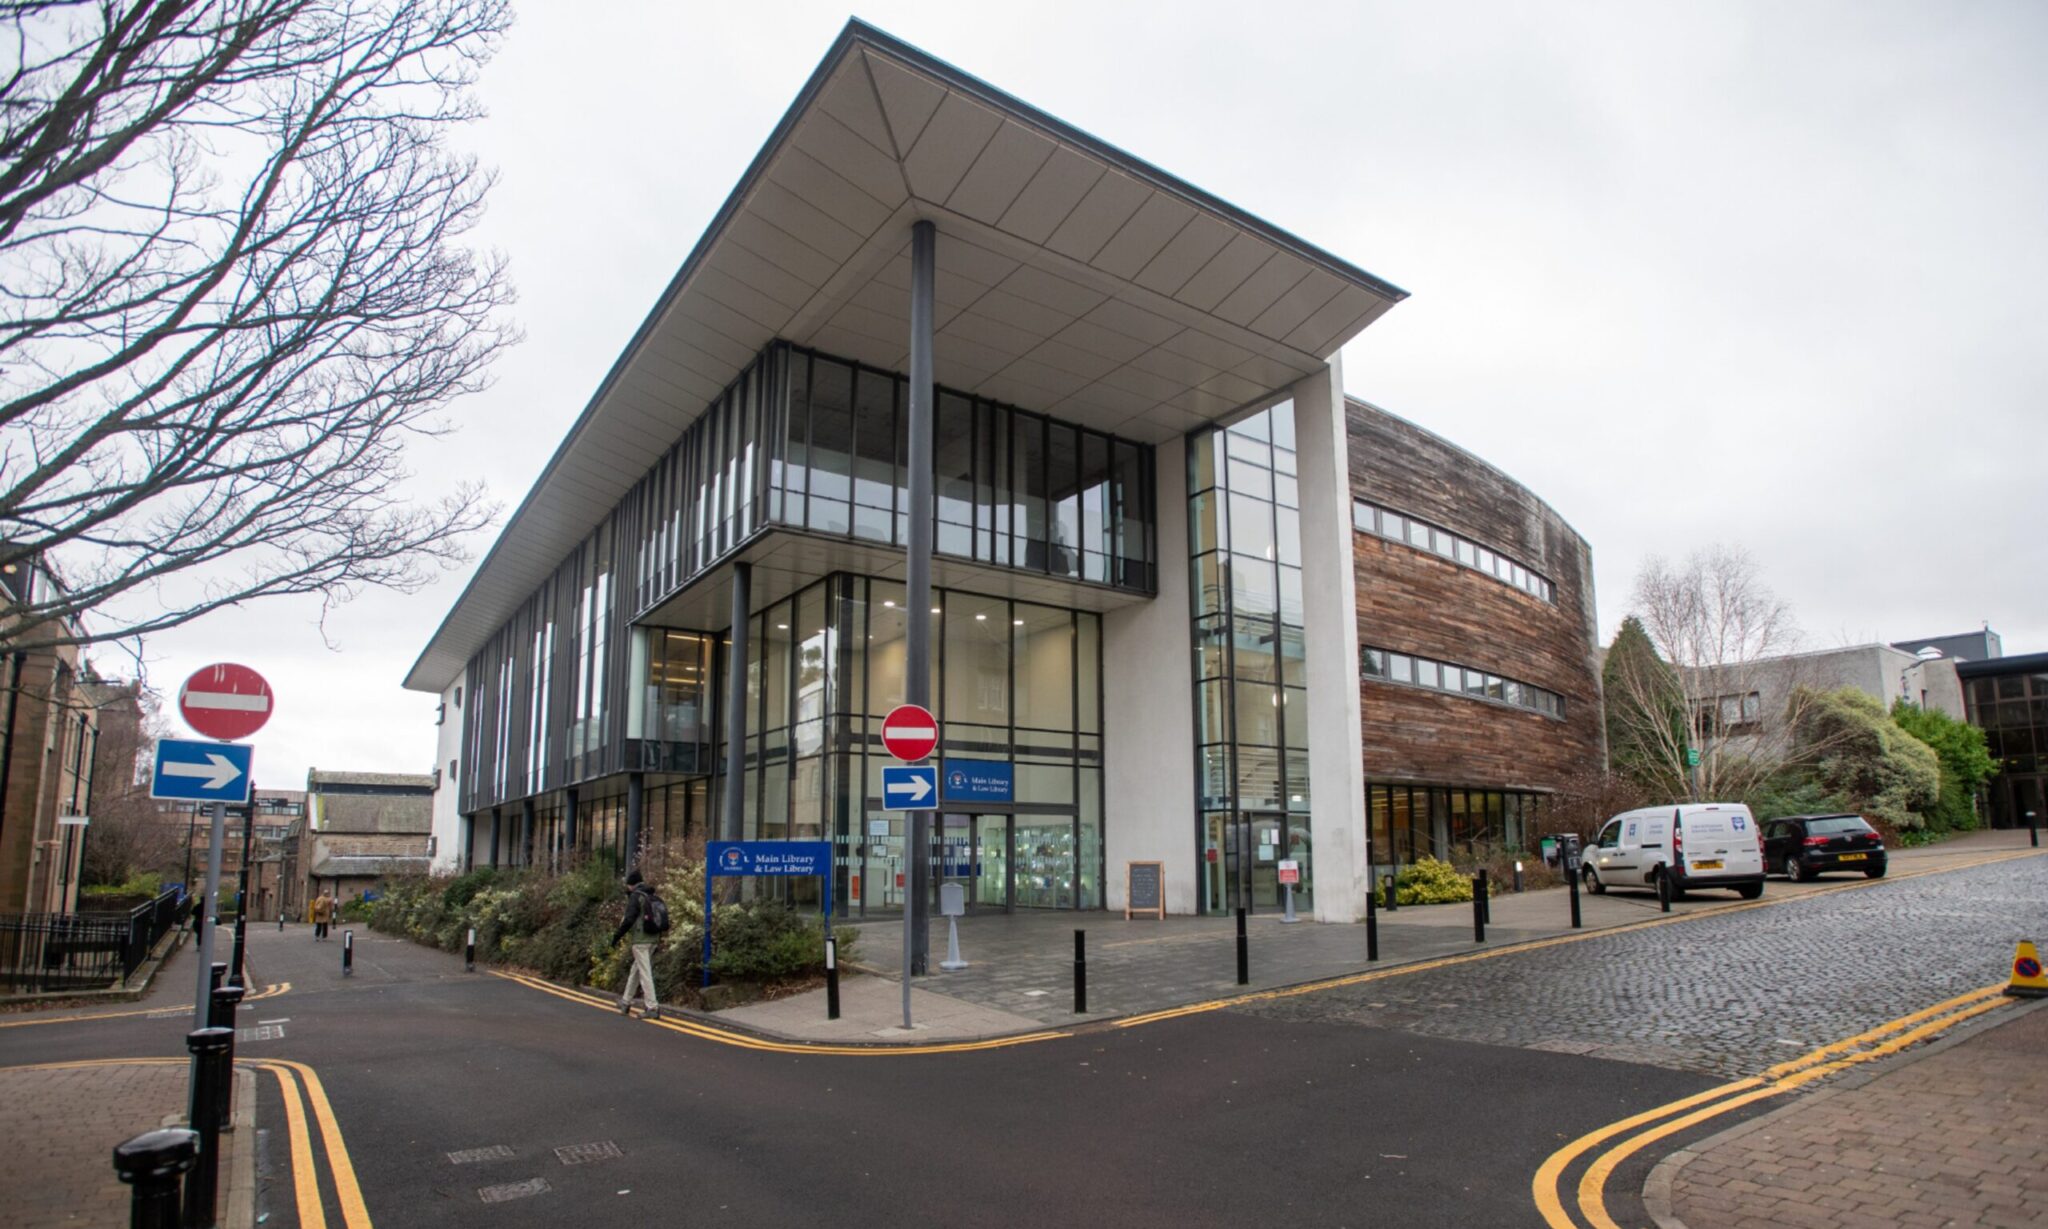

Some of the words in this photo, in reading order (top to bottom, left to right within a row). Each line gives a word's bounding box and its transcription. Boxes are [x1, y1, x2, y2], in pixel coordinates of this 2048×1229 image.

[971, 776, 986, 784] Main
[988, 777, 1009, 786] Library
[989, 786, 1008, 794] Library
[755, 854, 779, 863] Main
[781, 854, 815, 864] Library
[754, 864, 762, 873] &
[764, 865, 782, 873] Law
[784, 864, 814, 875] Library
